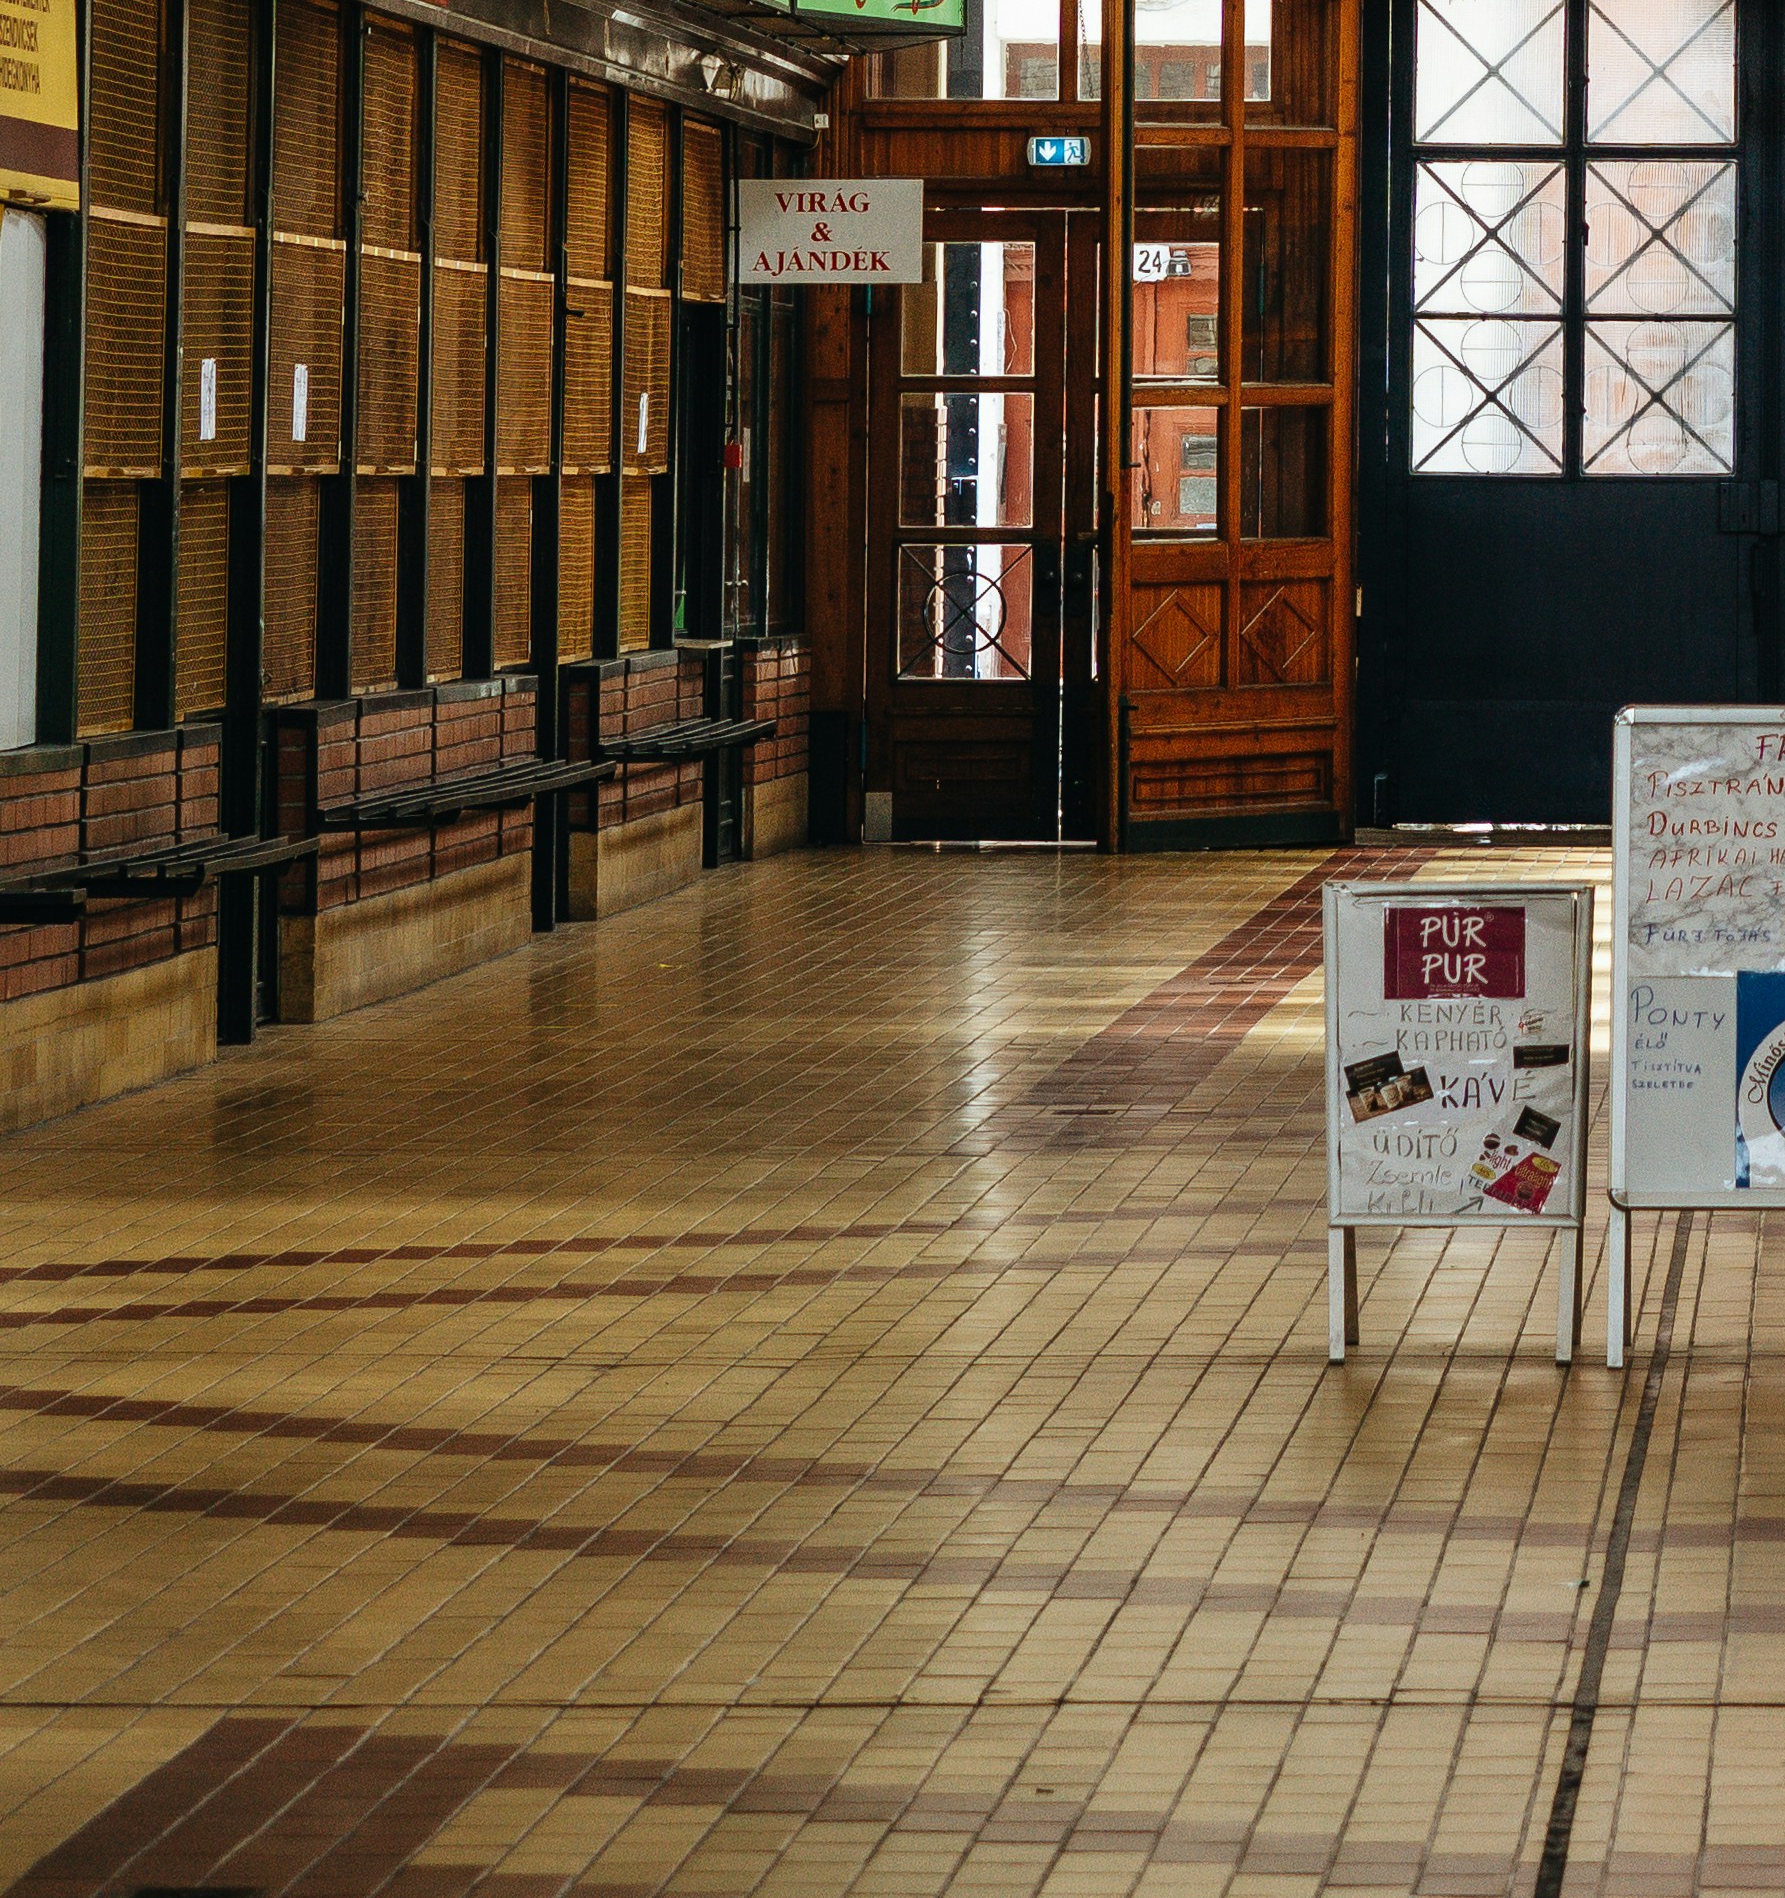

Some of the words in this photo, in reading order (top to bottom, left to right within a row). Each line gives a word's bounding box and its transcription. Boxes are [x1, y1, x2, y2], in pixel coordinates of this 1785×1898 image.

[774, 188, 871, 213] VIRÁG
[810, 222, 833, 242] &
[751, 246, 891, 277] AJÁNDÉK
[1138, 249, 1162, 273] 24
[1646, 875, 1752, 905] LAZAC
[1421, 953, 1489, 984] PUR
[1400, 1001, 1503, 1026] KENYÉR
[1396, 1027, 1508, 1051] KAPHATÓ
[1635, 1032, 1668, 1050] ÉLŐ
[1440, 1071, 1536, 1109] KÁVÉ
[1372, 1127, 1459, 1160] ÜDÍTŐ
[1365, 1160, 1452, 1185] Zsemle
